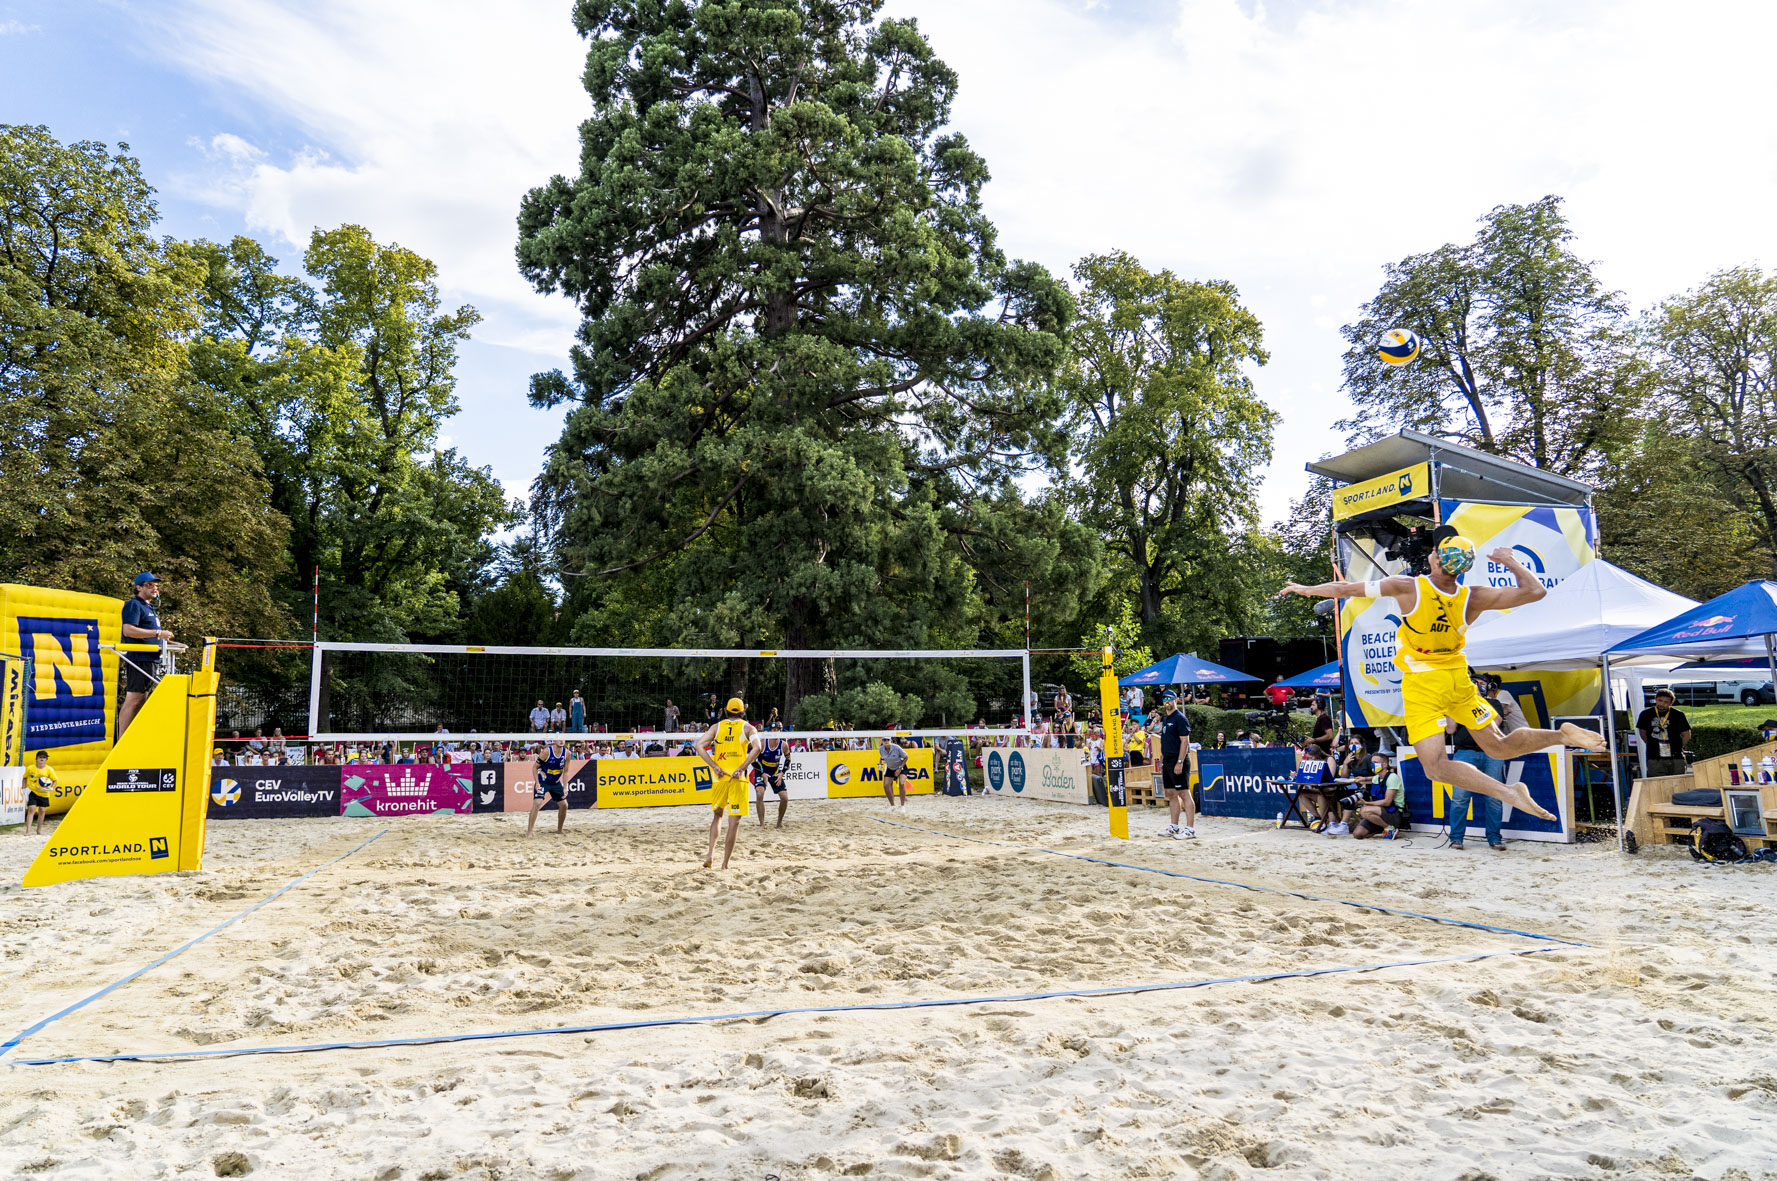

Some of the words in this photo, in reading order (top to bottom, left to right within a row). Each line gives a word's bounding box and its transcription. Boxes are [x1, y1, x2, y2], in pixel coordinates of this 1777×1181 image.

[1343, 484, 1396, 505] SPORT.LAND.
[1488, 562, 1531, 573] BEAH
[1430, 623, 1451, 632] AUT
[1672, 629, 1702, 639] Red
[1702, 624, 1734, 635] Bull
[1361, 631, 1396, 645] BEACH
[1365, 661, 1395, 674] BADEN
[30, 718, 101, 732] NIEDERÖSTERREICH
[728, 726, 732, 736] 1
[599, 773, 691, 786] SPORT.LAND.
[1042, 764, 1076, 790] Baden
[54, 784, 88, 797] SPO
[255, 779, 281, 790] CEV
[514, 781, 536, 794] CE
[1225, 775, 1262, 793] HYPO
[255, 790, 334, 804] EuroVolleyTV
[612, 787, 685, 797] www.sportlandnoe.at
[376, 799, 438, 811] kronehit
[49, 843, 146, 857] SPORT.LAND.
